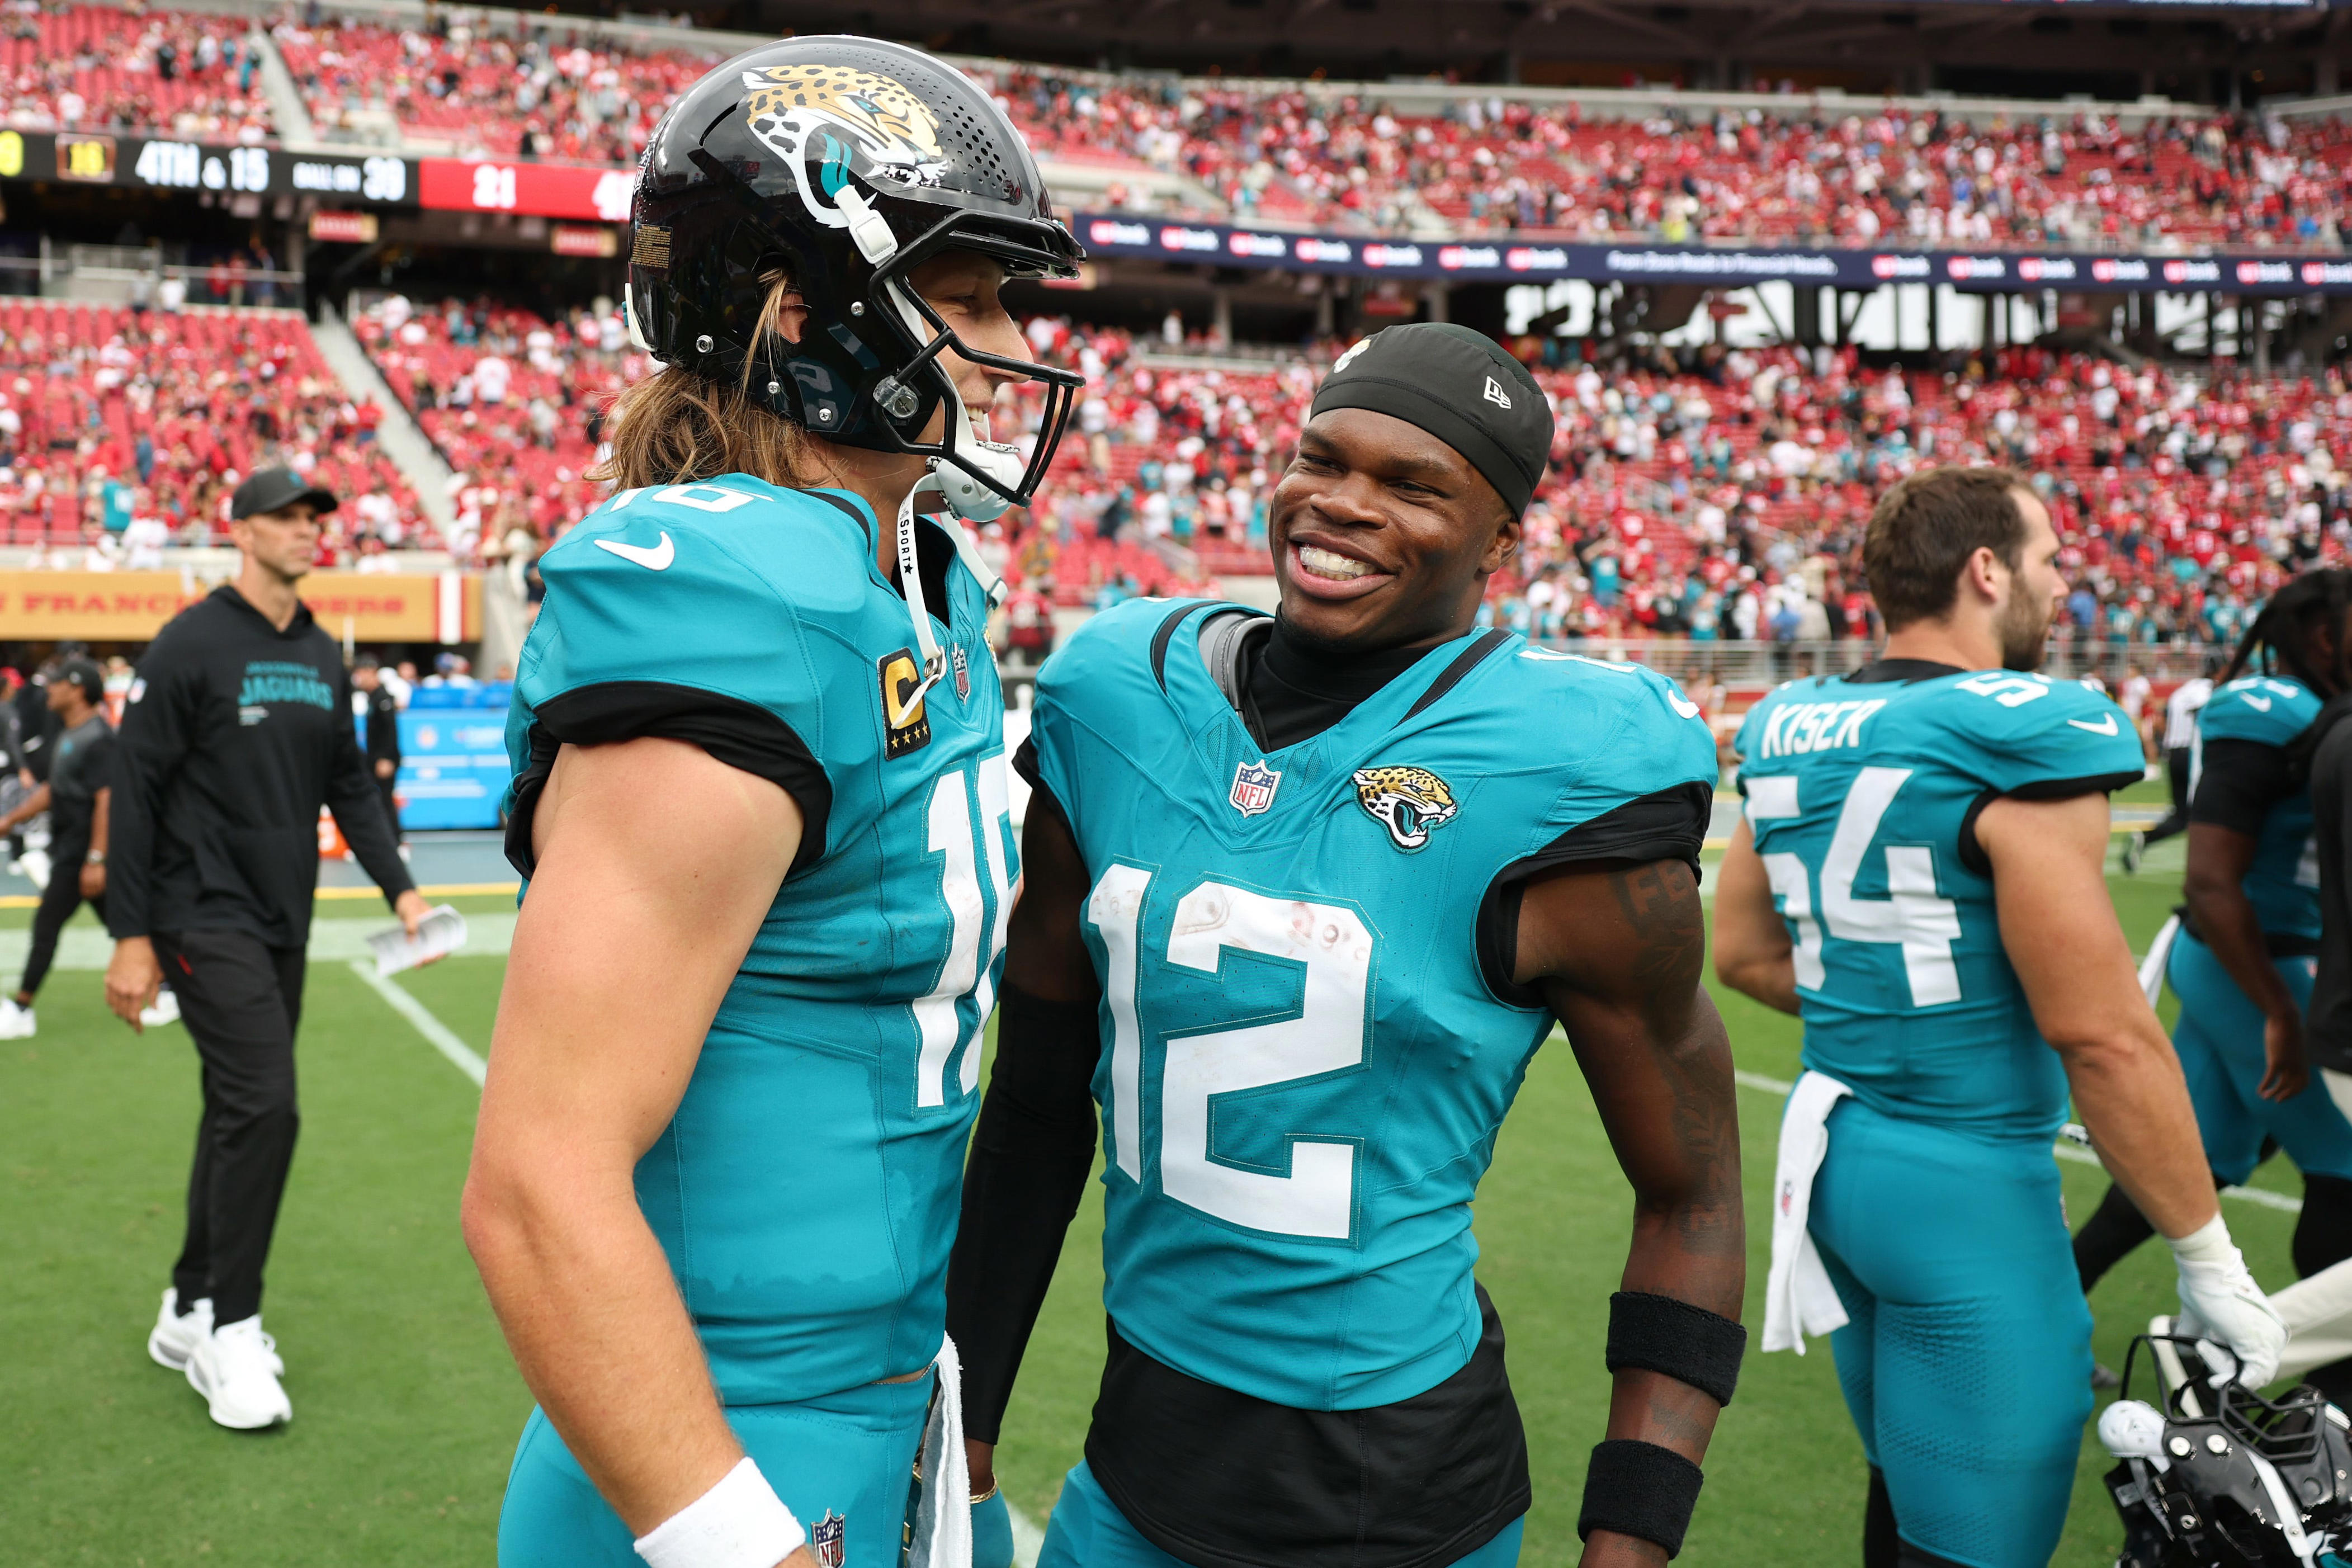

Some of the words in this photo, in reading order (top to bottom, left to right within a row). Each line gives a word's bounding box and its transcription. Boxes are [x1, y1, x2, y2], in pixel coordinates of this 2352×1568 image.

[135, 141, 200, 187] 4TH
[900, 519, 911, 561] SPORT
[238, 676, 333, 711] JAGUARS
[885, 657, 923, 730] C
[1761, 698, 1887, 759] KISER
[1236, 783, 1264, 807] NFL
[1744, 767, 1962, 1008] 54
[1088, 864, 1373, 1239] 12
[820, 1539, 842, 1567] NFL
